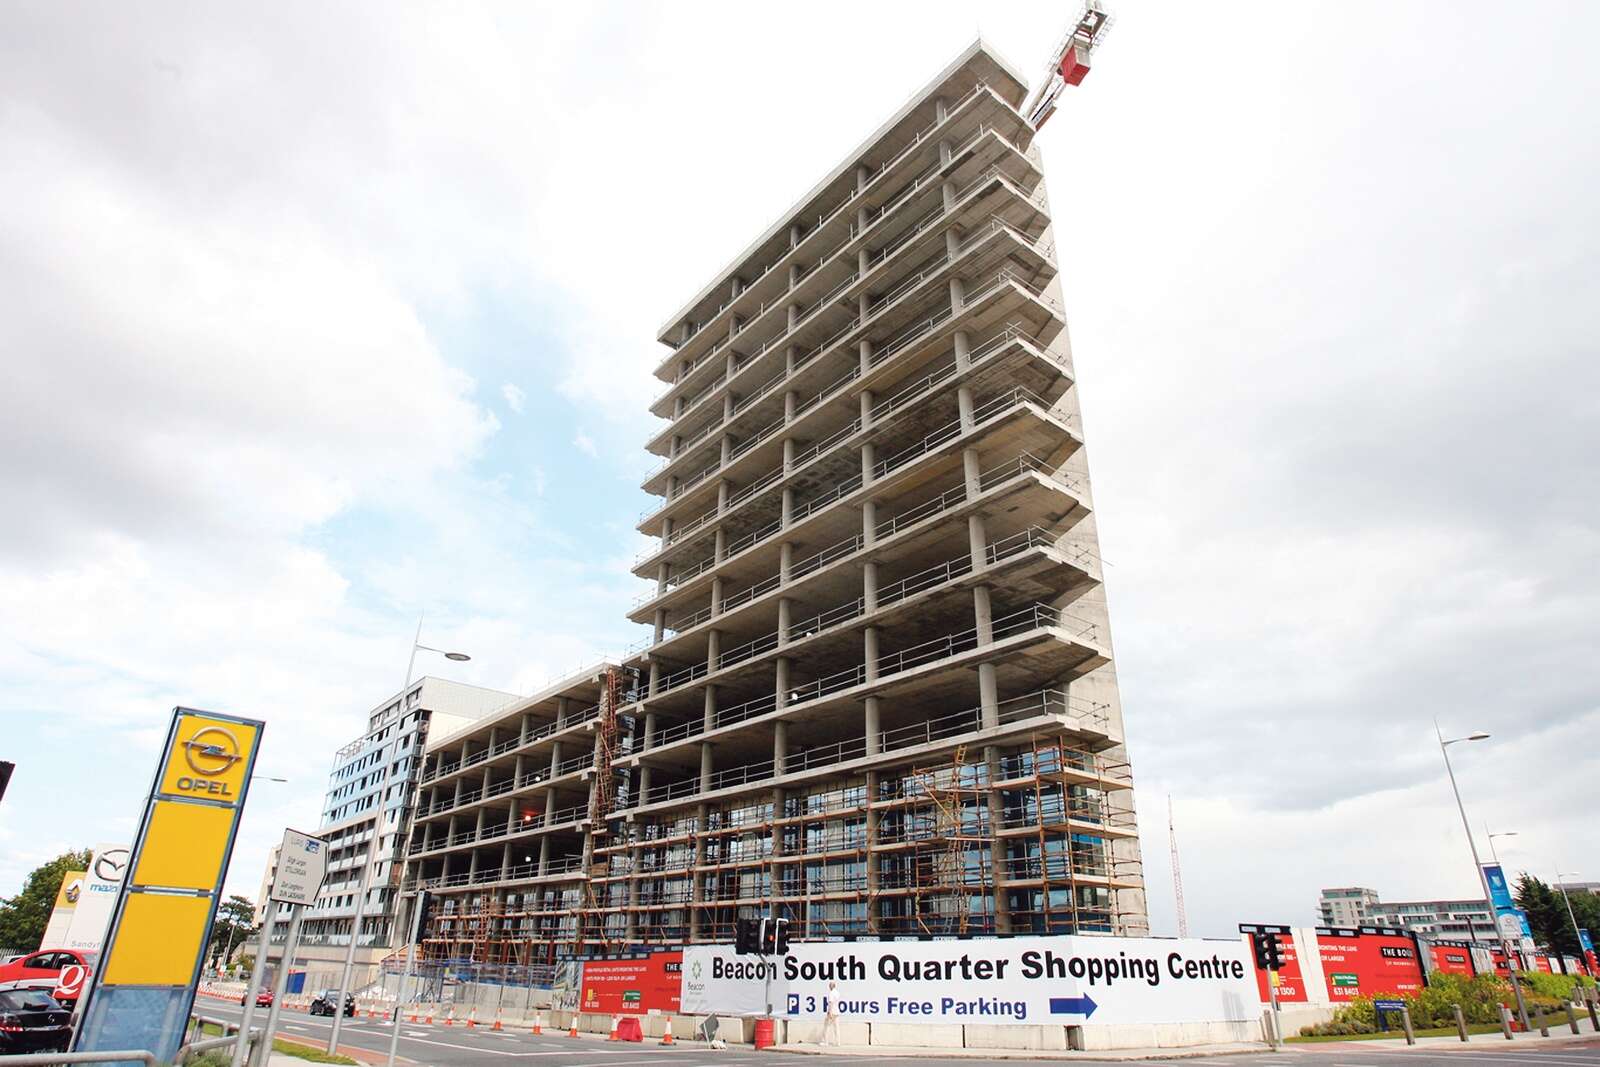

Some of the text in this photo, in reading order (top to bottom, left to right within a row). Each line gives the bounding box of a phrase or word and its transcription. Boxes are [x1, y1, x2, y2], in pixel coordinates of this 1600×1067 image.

[177, 777, 232, 795] OPEL
[1382, 948, 1396, 956] THE
[56, 965, 85, 995] Q
[712, 951, 1244, 986] Beacon South Quarter Shopping Centre
[806, 996, 816, 1012] 3
[887, 997, 933, 1014] Free
[941, 997, 1027, 1020] Parking
